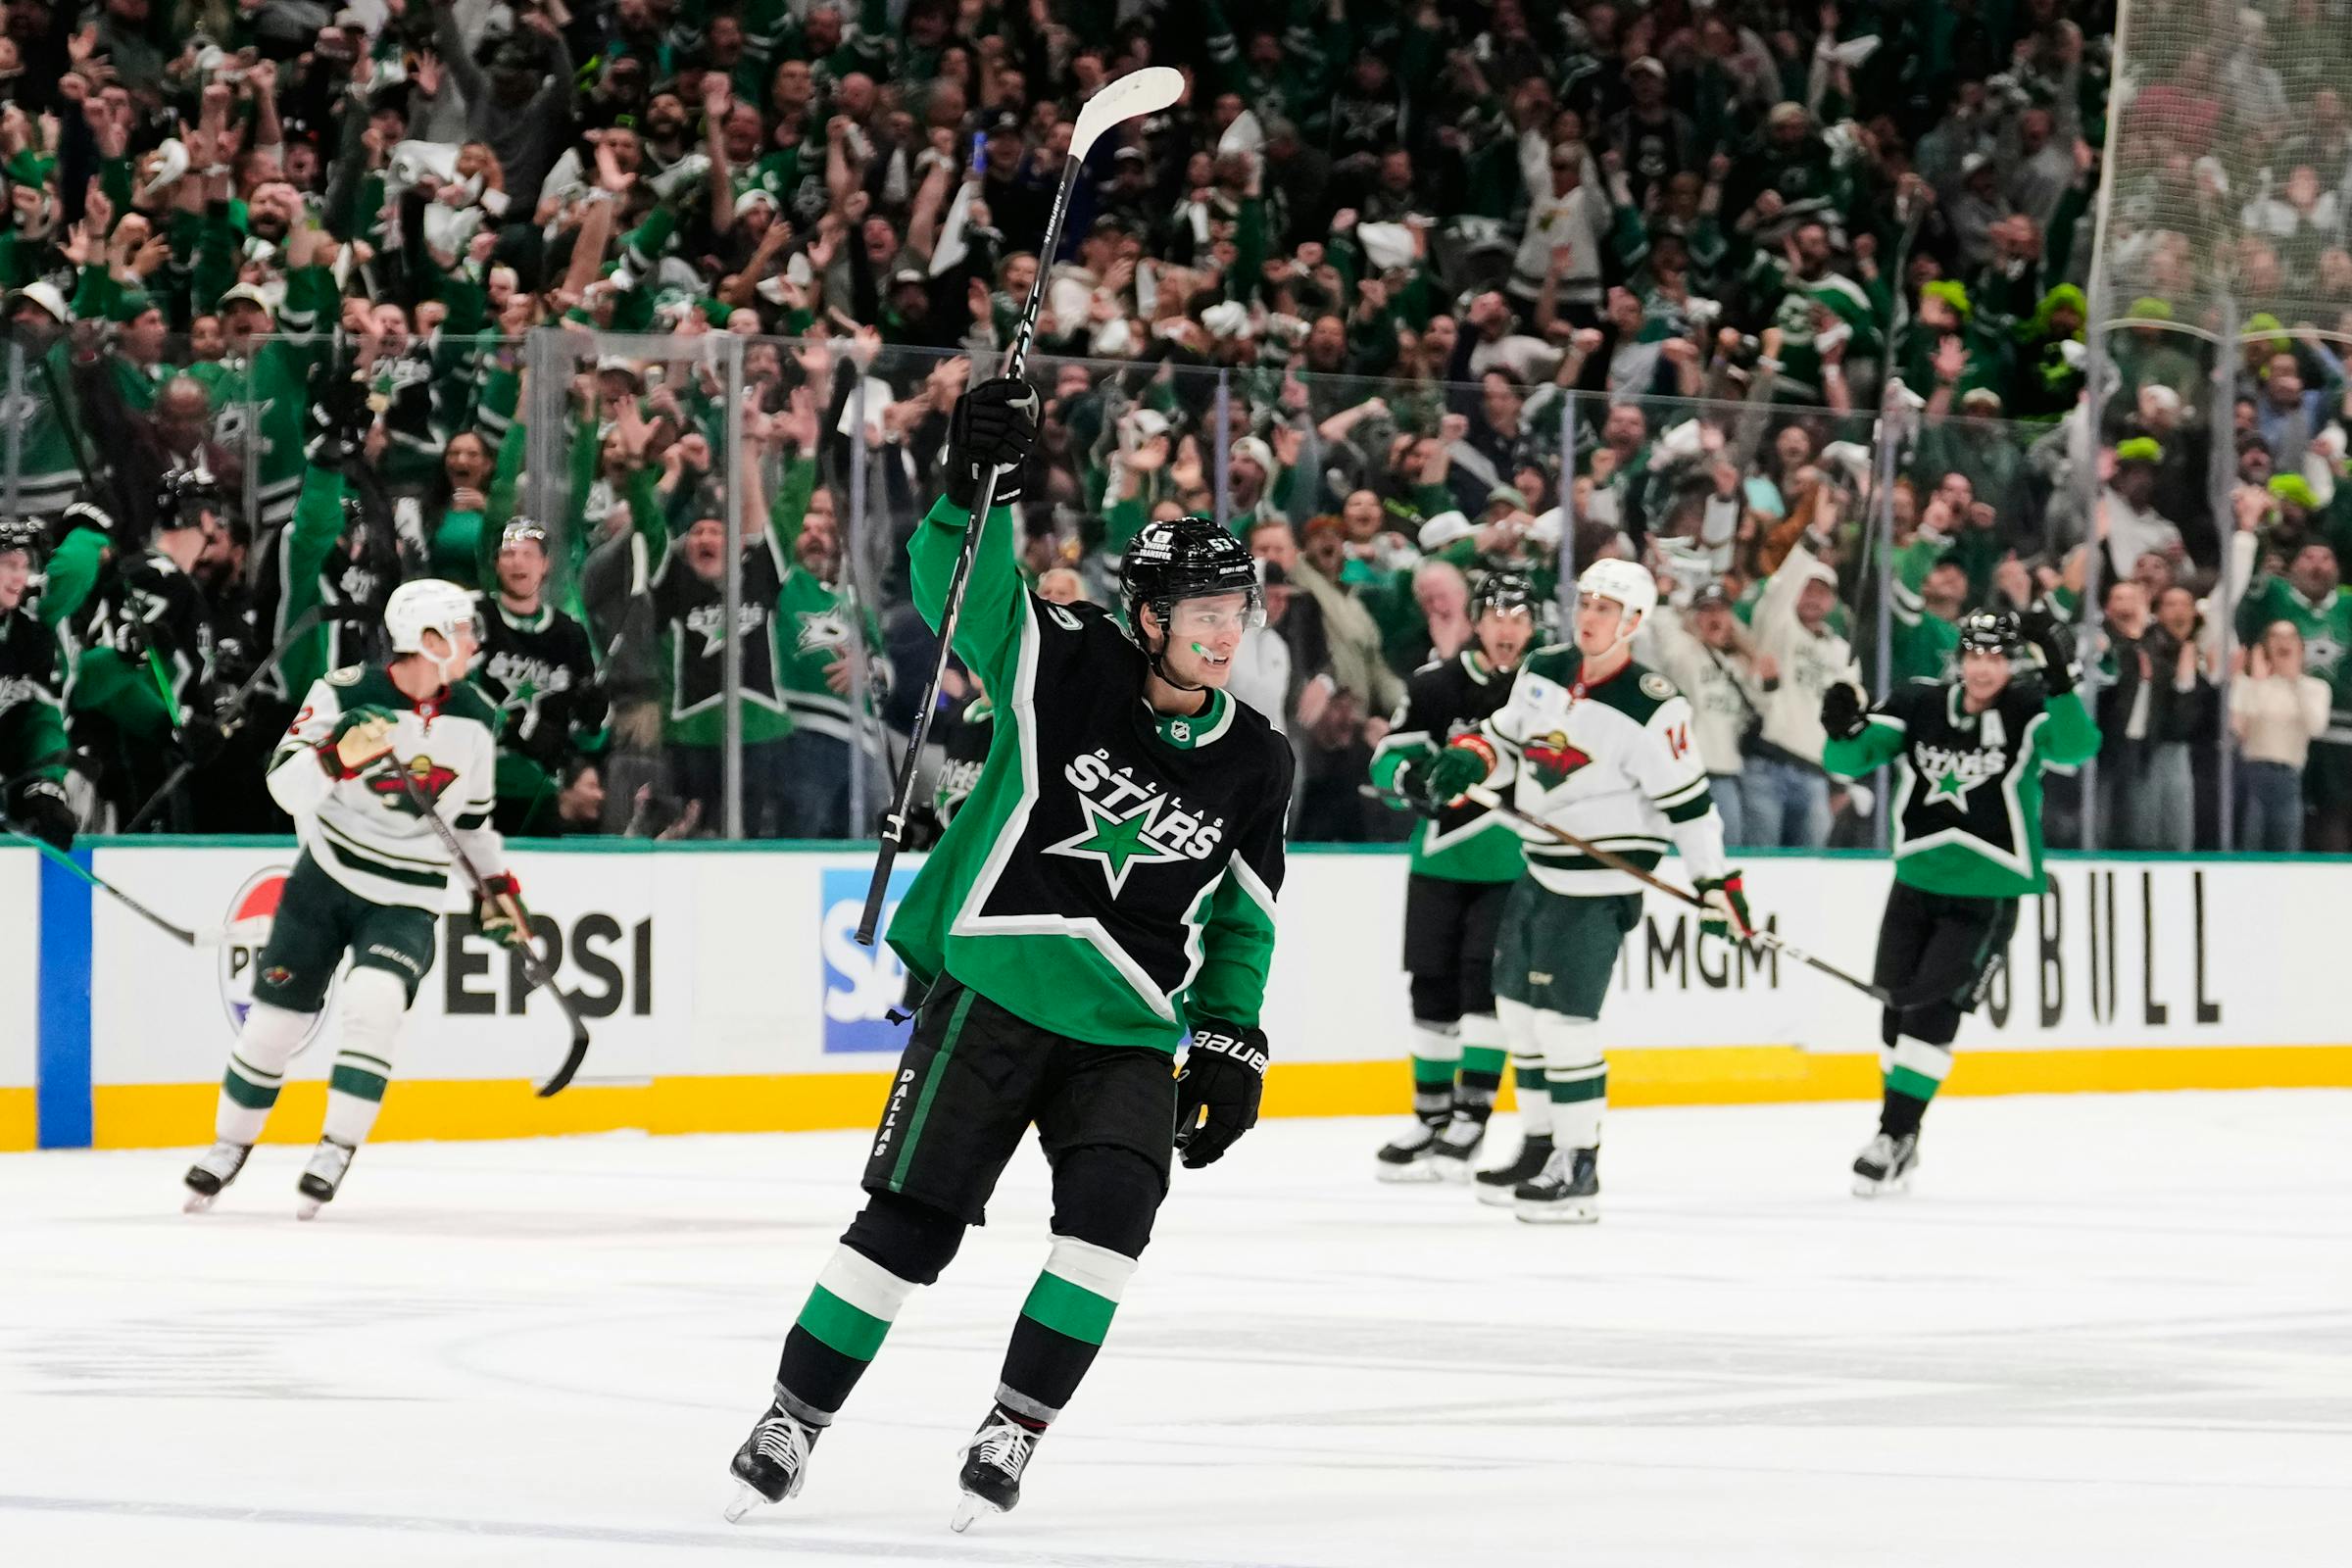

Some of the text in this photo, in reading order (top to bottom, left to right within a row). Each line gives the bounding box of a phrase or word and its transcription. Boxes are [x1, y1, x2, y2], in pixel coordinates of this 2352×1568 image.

[1139, 549, 1173, 561] TRANSFER
[1143, 541, 1172, 552] ENERGY
[1207, 537, 1234, 552] 53
[1665, 721, 1690, 760] 14
[1980, 709, 2007, 747] A
[1064, 754, 1222, 860] STARS
[1094, 748, 1223, 828] DALLAS
[821, 899, 907, 1023] SA
[874, 1068, 915, 1156] DALLAS
